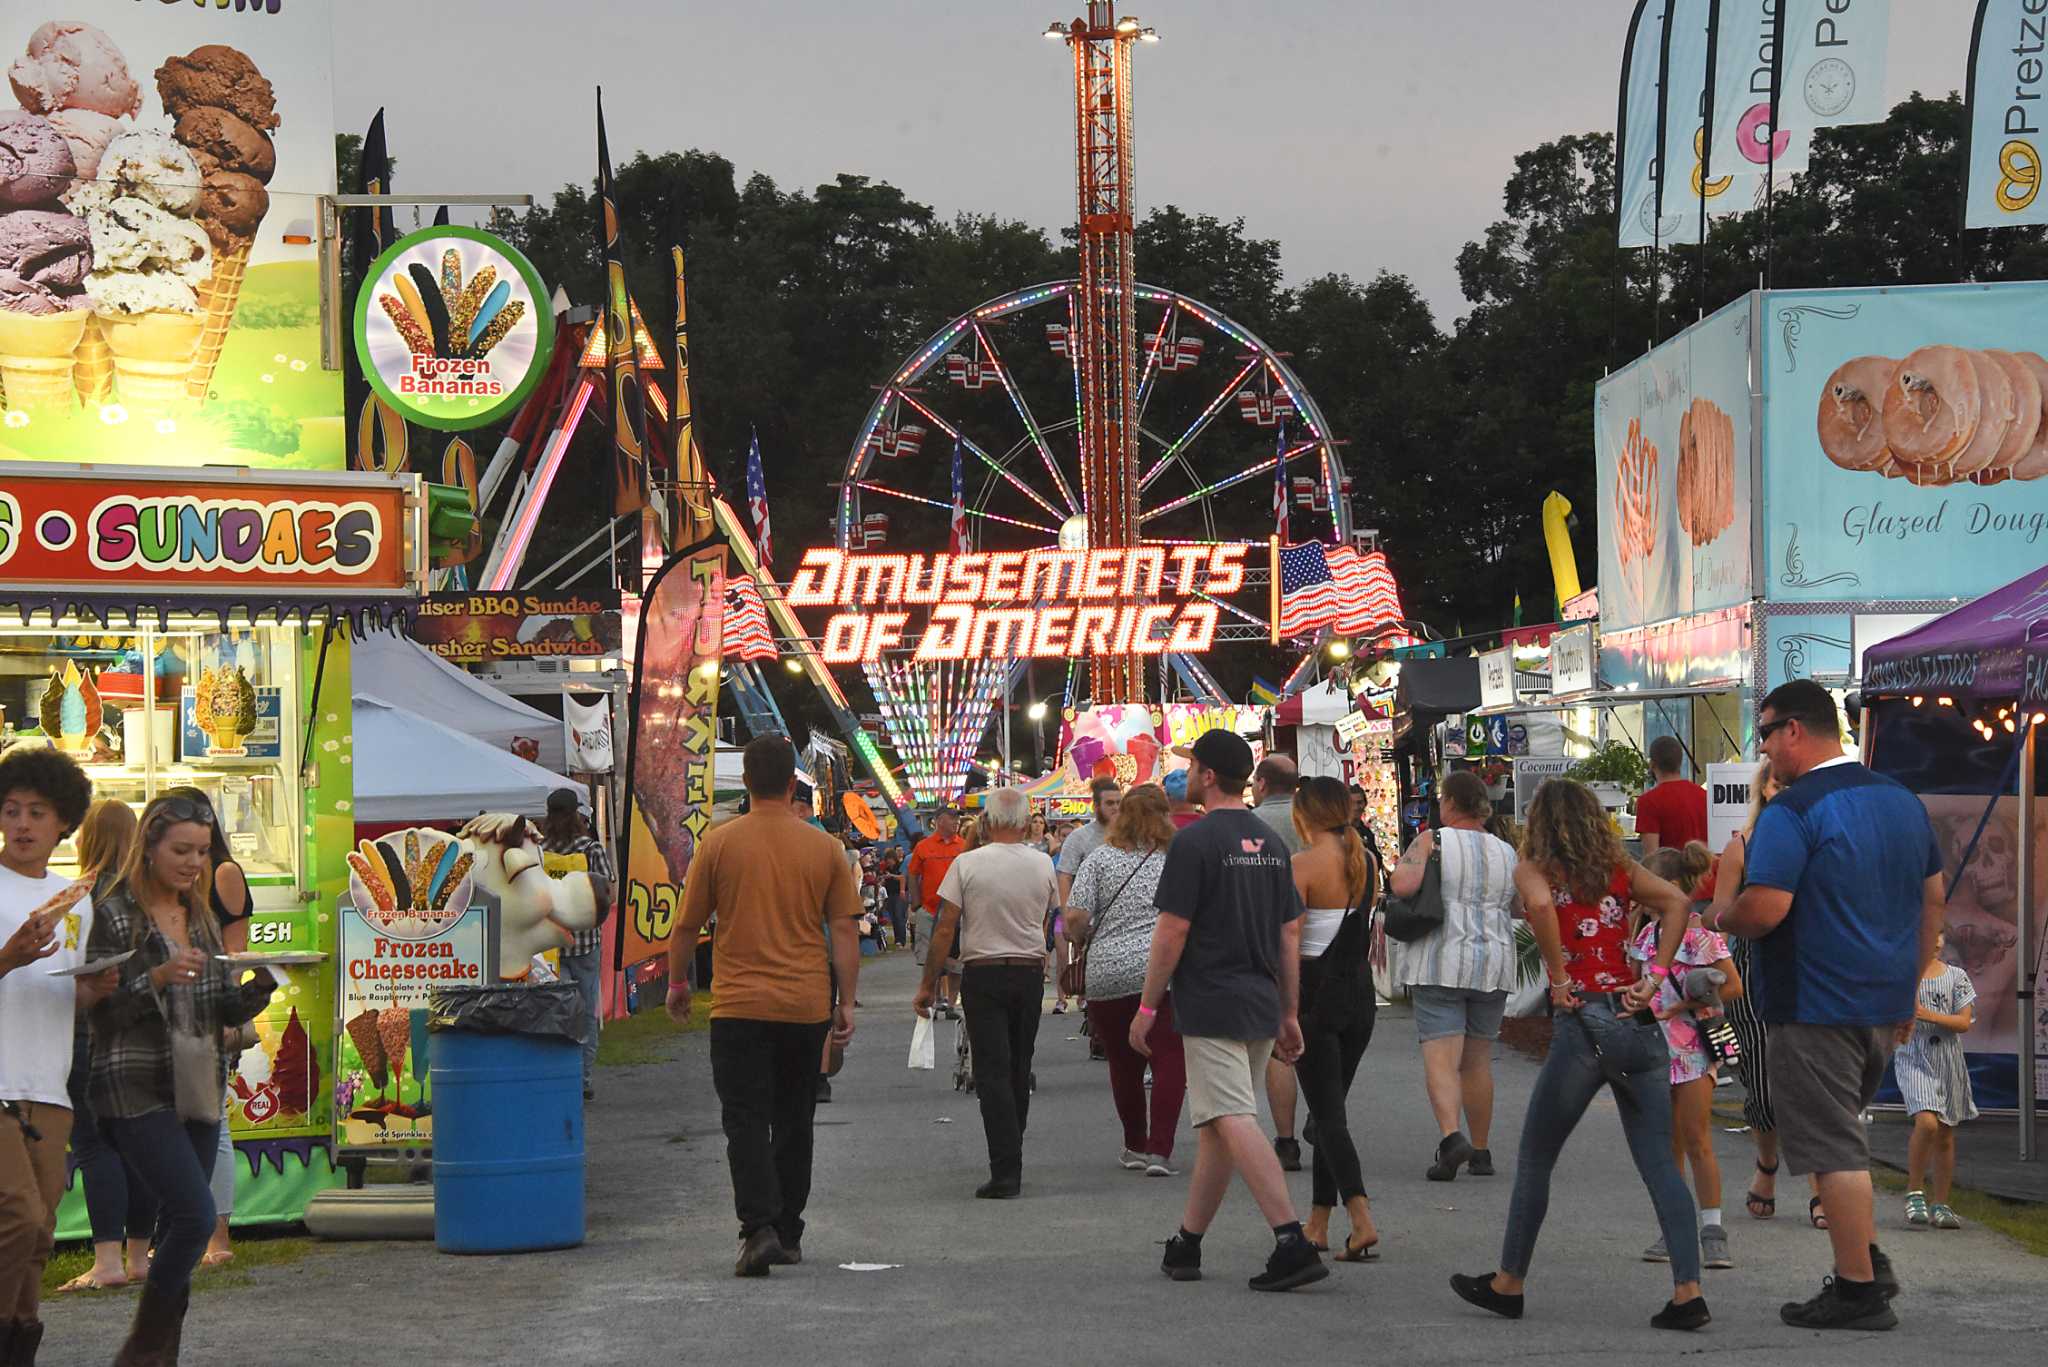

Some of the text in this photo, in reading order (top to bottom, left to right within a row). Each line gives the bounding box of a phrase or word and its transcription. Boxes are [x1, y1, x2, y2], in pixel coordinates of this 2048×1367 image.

[411, 354, 491, 374] Frozen
[400, 375, 502, 395] Bananas
[1843, 500, 1948, 546] Glazed
[95, 500, 375, 568] SUNDAES
[783, 542, 1250, 606] AMUSEMENTS
[467, 597, 519, 617] BBQ
[523, 595, 602, 614] Sundae
[822, 602, 1219, 664] OF AMERICA
[490, 637, 605, 656] Sandwich
[1922, 652, 1978, 687] TATTOOS
[1169, 705, 1237, 747] CANDY
[1519, 760, 1563, 773] Coconut
[1060, 800, 1089, 814] SNO
[367, 909, 457, 919] Frozen Bananas
[374, 937, 454, 959] Frozen
[348, 958, 479, 980] Cheesecake
[348, 993, 367, 1001] Blue
[369, 993, 412, 1002] Raspberry
[374, 984, 415, 992] Chocolate
[250, 1099, 271, 1111] REAL
[374, 1130, 427, 1140] add Sprinkles
